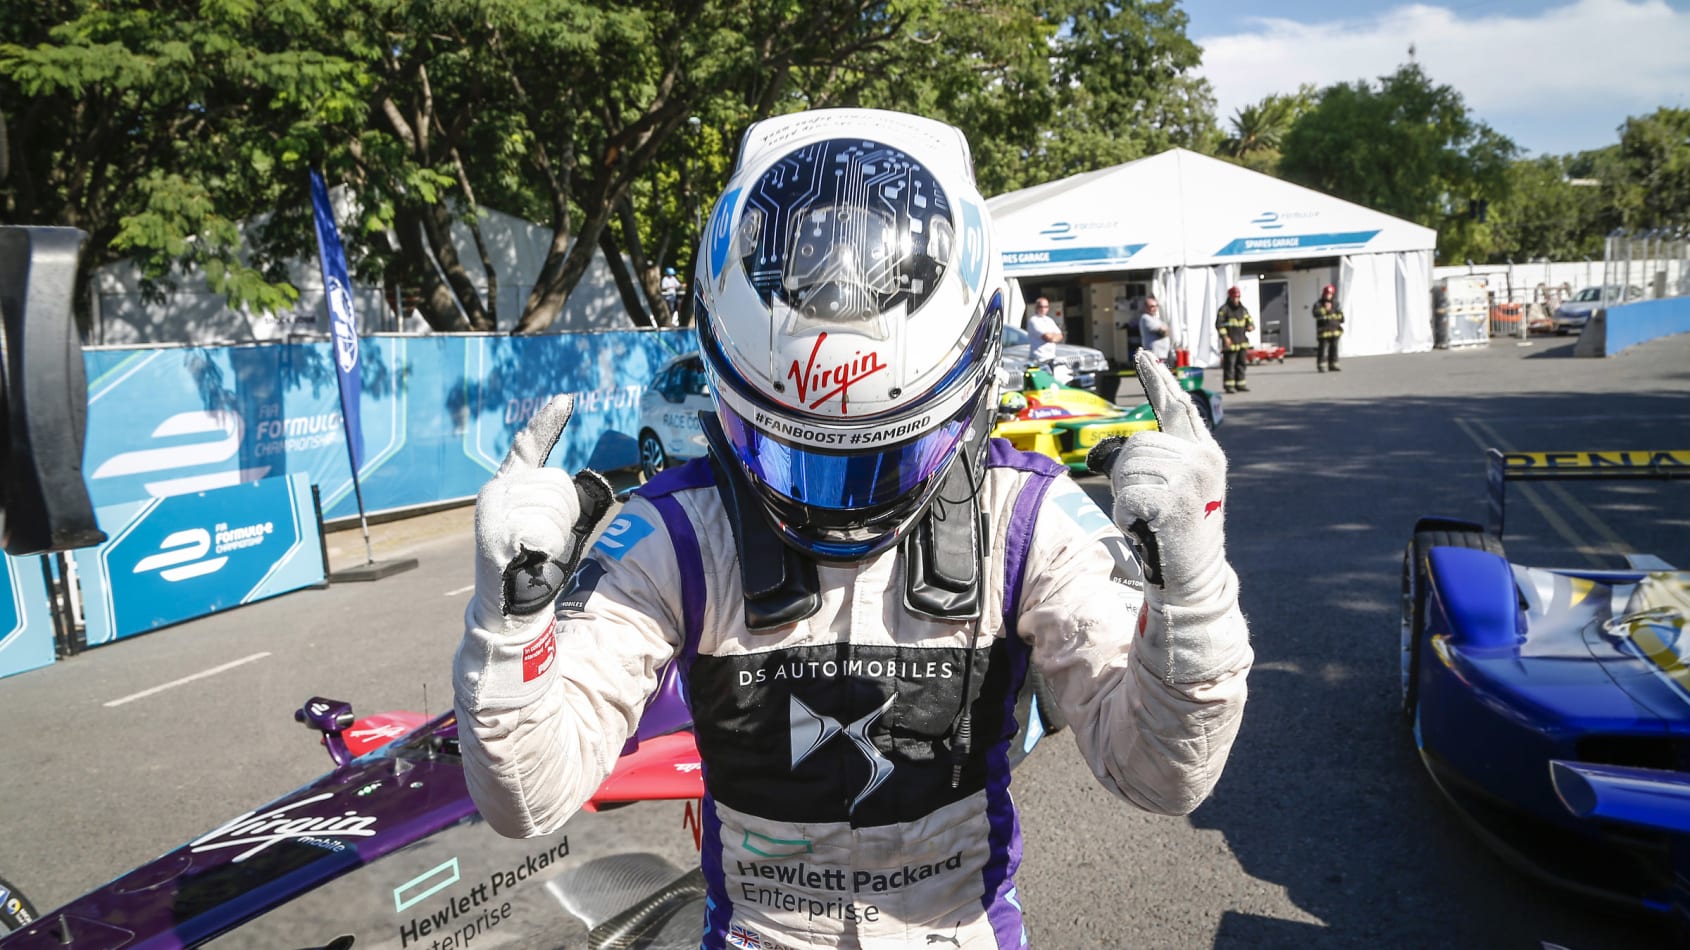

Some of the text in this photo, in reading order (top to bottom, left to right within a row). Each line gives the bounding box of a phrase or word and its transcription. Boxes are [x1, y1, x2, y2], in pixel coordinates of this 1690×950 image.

[1018, 252, 1050, 263] GARAGE
[1272, 237, 1299, 247] GARAGE
[787, 332, 887, 414] Virgin
[663, 413, 685, 429] RACE
[755, 412, 931, 445] #FANBOOST #SAMBIRD
[738, 659, 954, 687] DS AUTOMOBILES
[190, 792, 377, 863] Virgin
[298, 835, 346, 853] mobile
[737, 851, 963, 894] Hewlett Packard
[400, 835, 570, 949] Hewlett Packard
[741, 882, 880, 924] Enterprise
[427, 902, 512, 950] terprise
